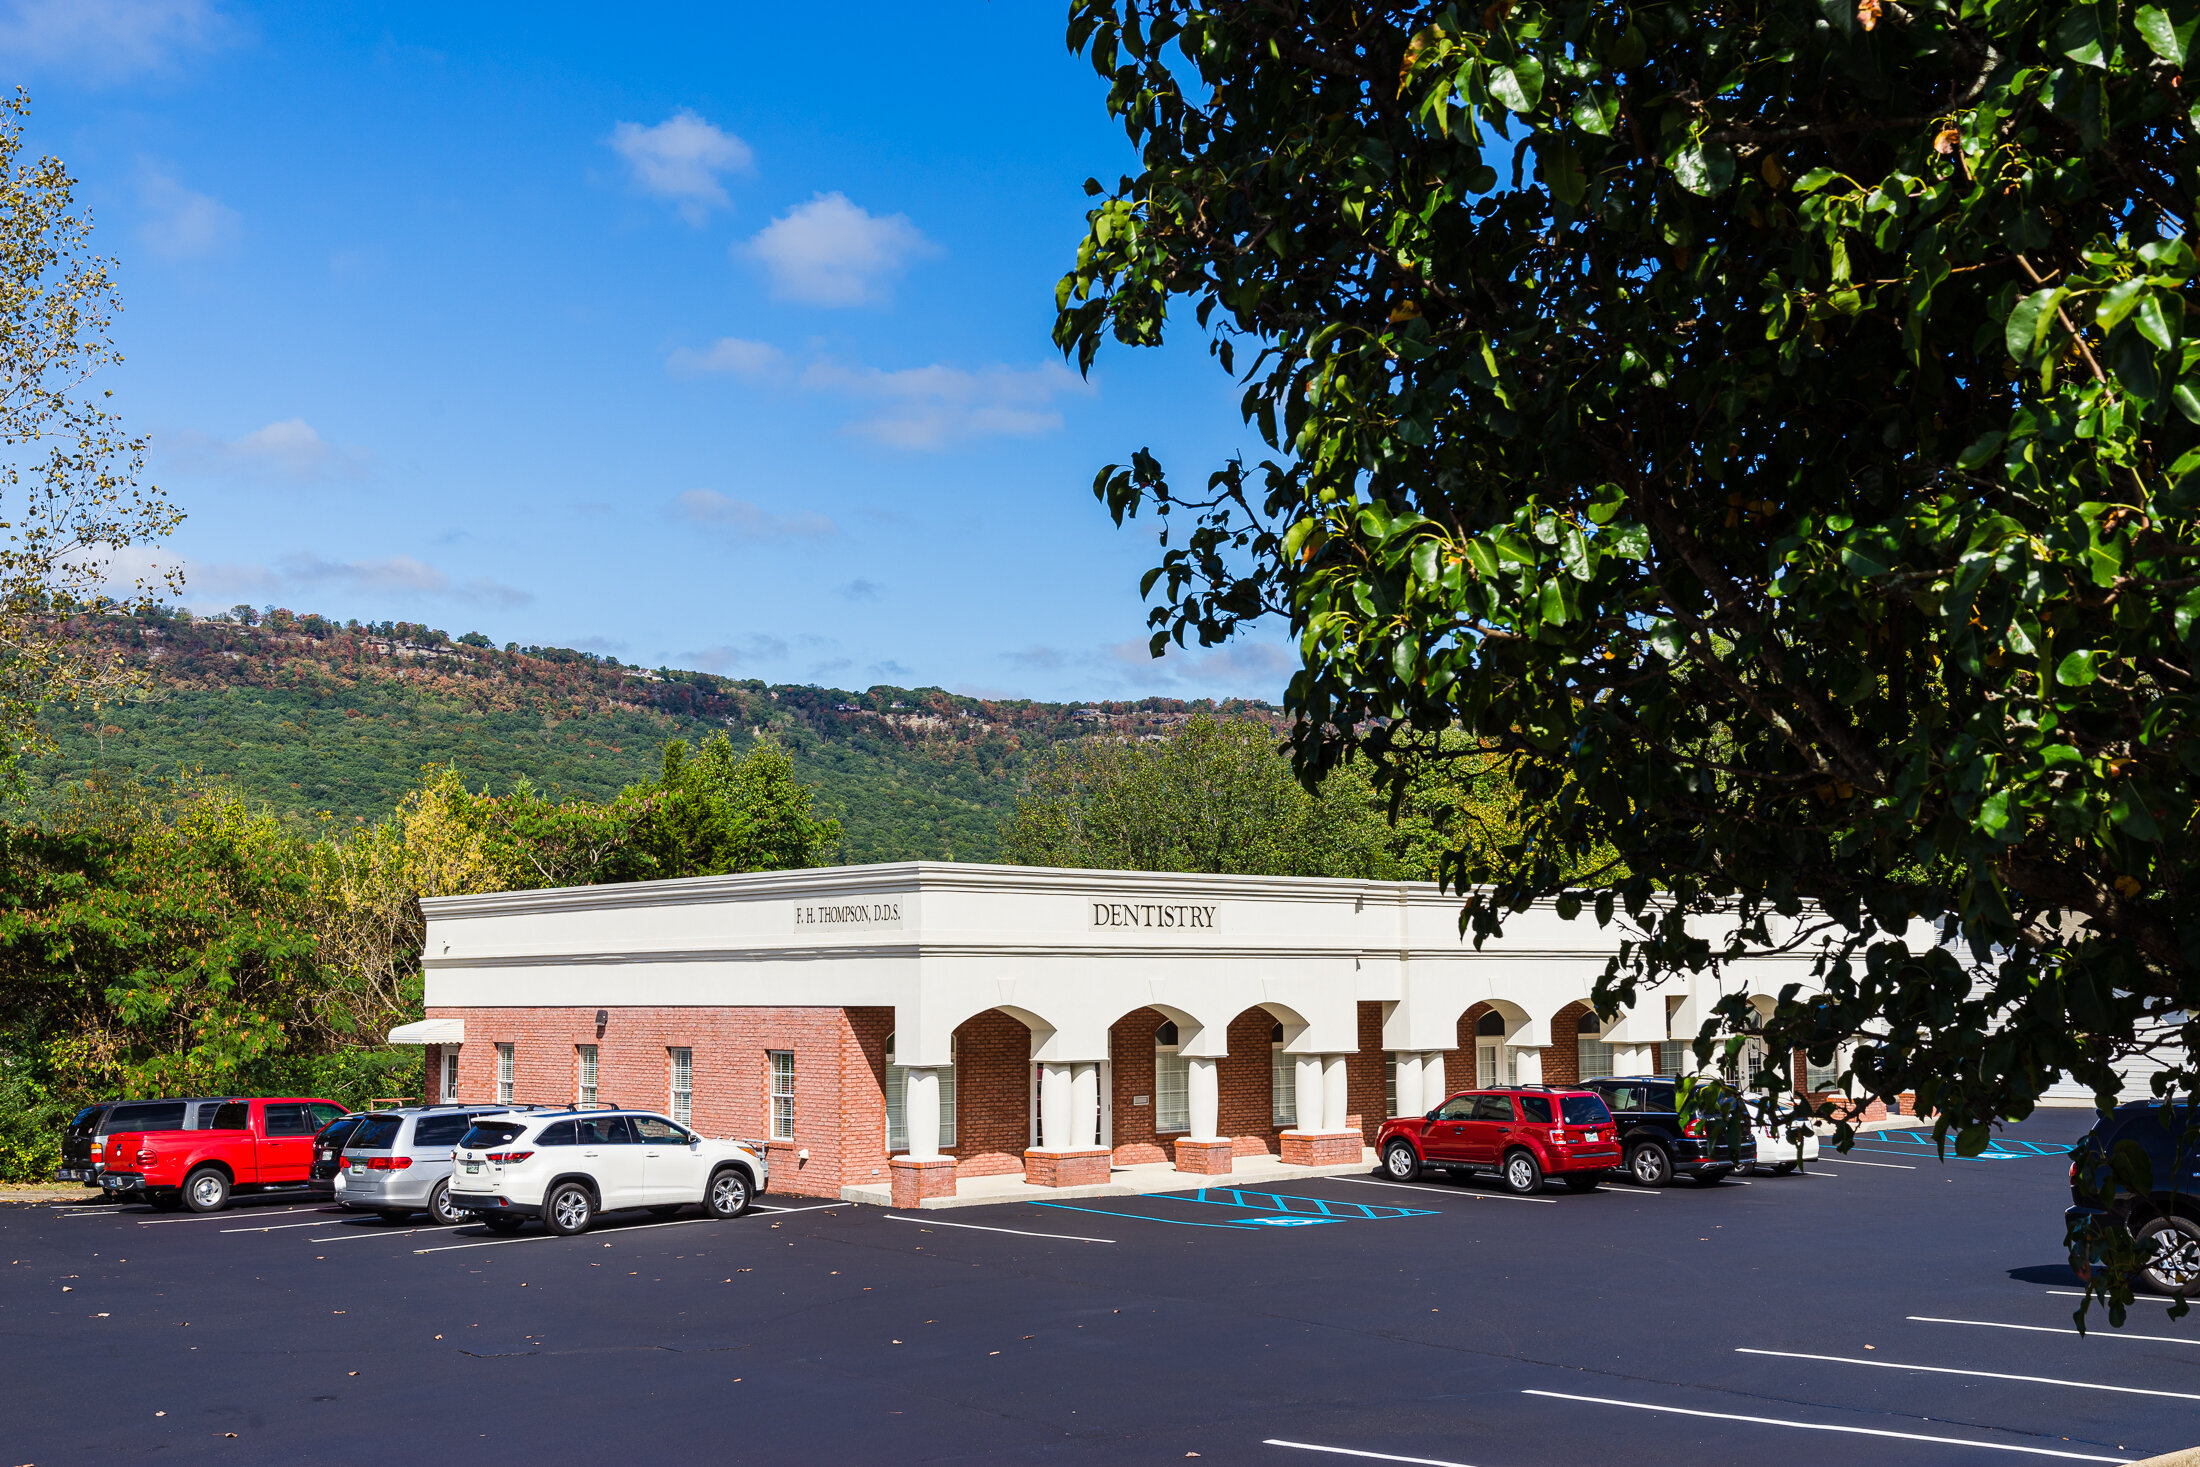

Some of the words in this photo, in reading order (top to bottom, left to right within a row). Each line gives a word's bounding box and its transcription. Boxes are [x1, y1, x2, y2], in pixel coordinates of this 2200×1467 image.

[796, 908, 804, 924] F.
[806, 907, 816, 924] H.
[818, 905, 871, 924] THOMPSON,
[874, 904, 901, 921] D.D.S.
[1093, 903, 1217, 928] DENTISTRY
